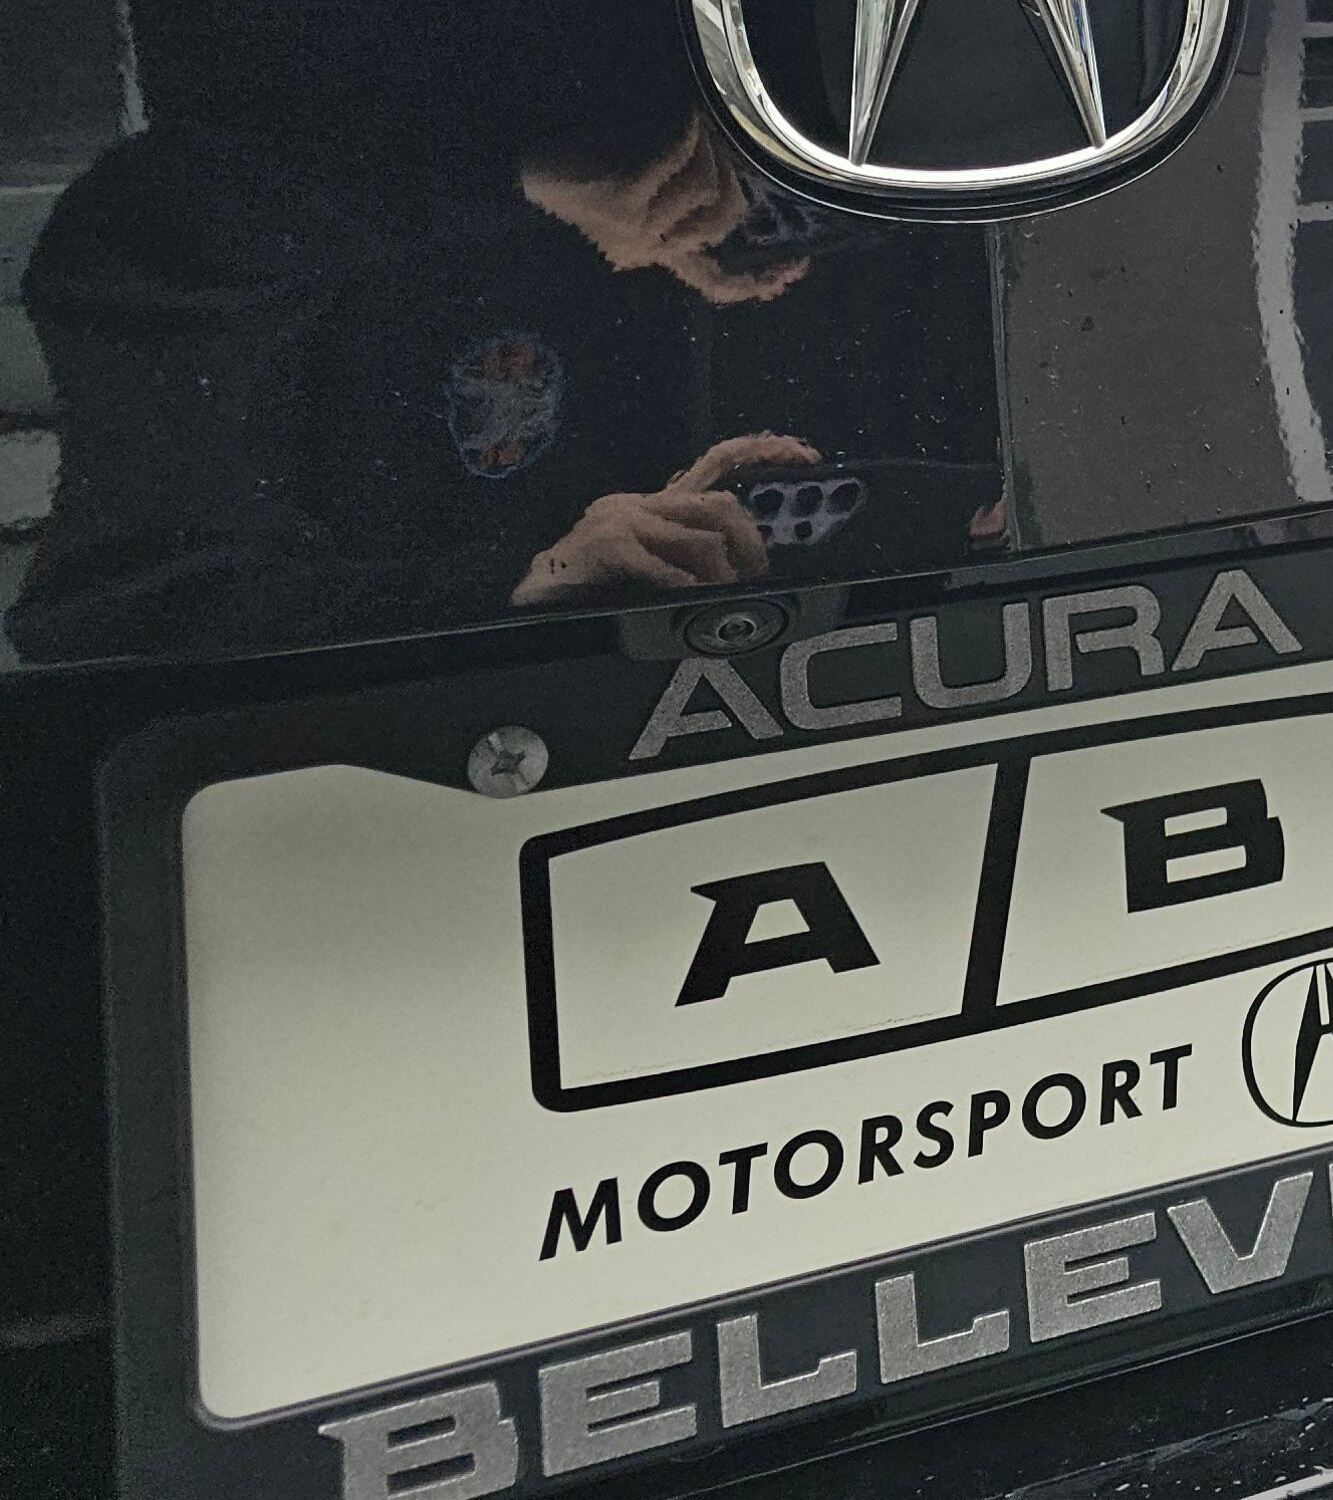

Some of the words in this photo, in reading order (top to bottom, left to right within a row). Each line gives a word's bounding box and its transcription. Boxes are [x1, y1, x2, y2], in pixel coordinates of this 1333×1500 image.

[628, 568, 1303, 761] ACURA
[675, 862, 880, 1007] A
[1099, 779, 1286, 913] B
[539, 1044, 1193, 1261] MOTORSPORT
